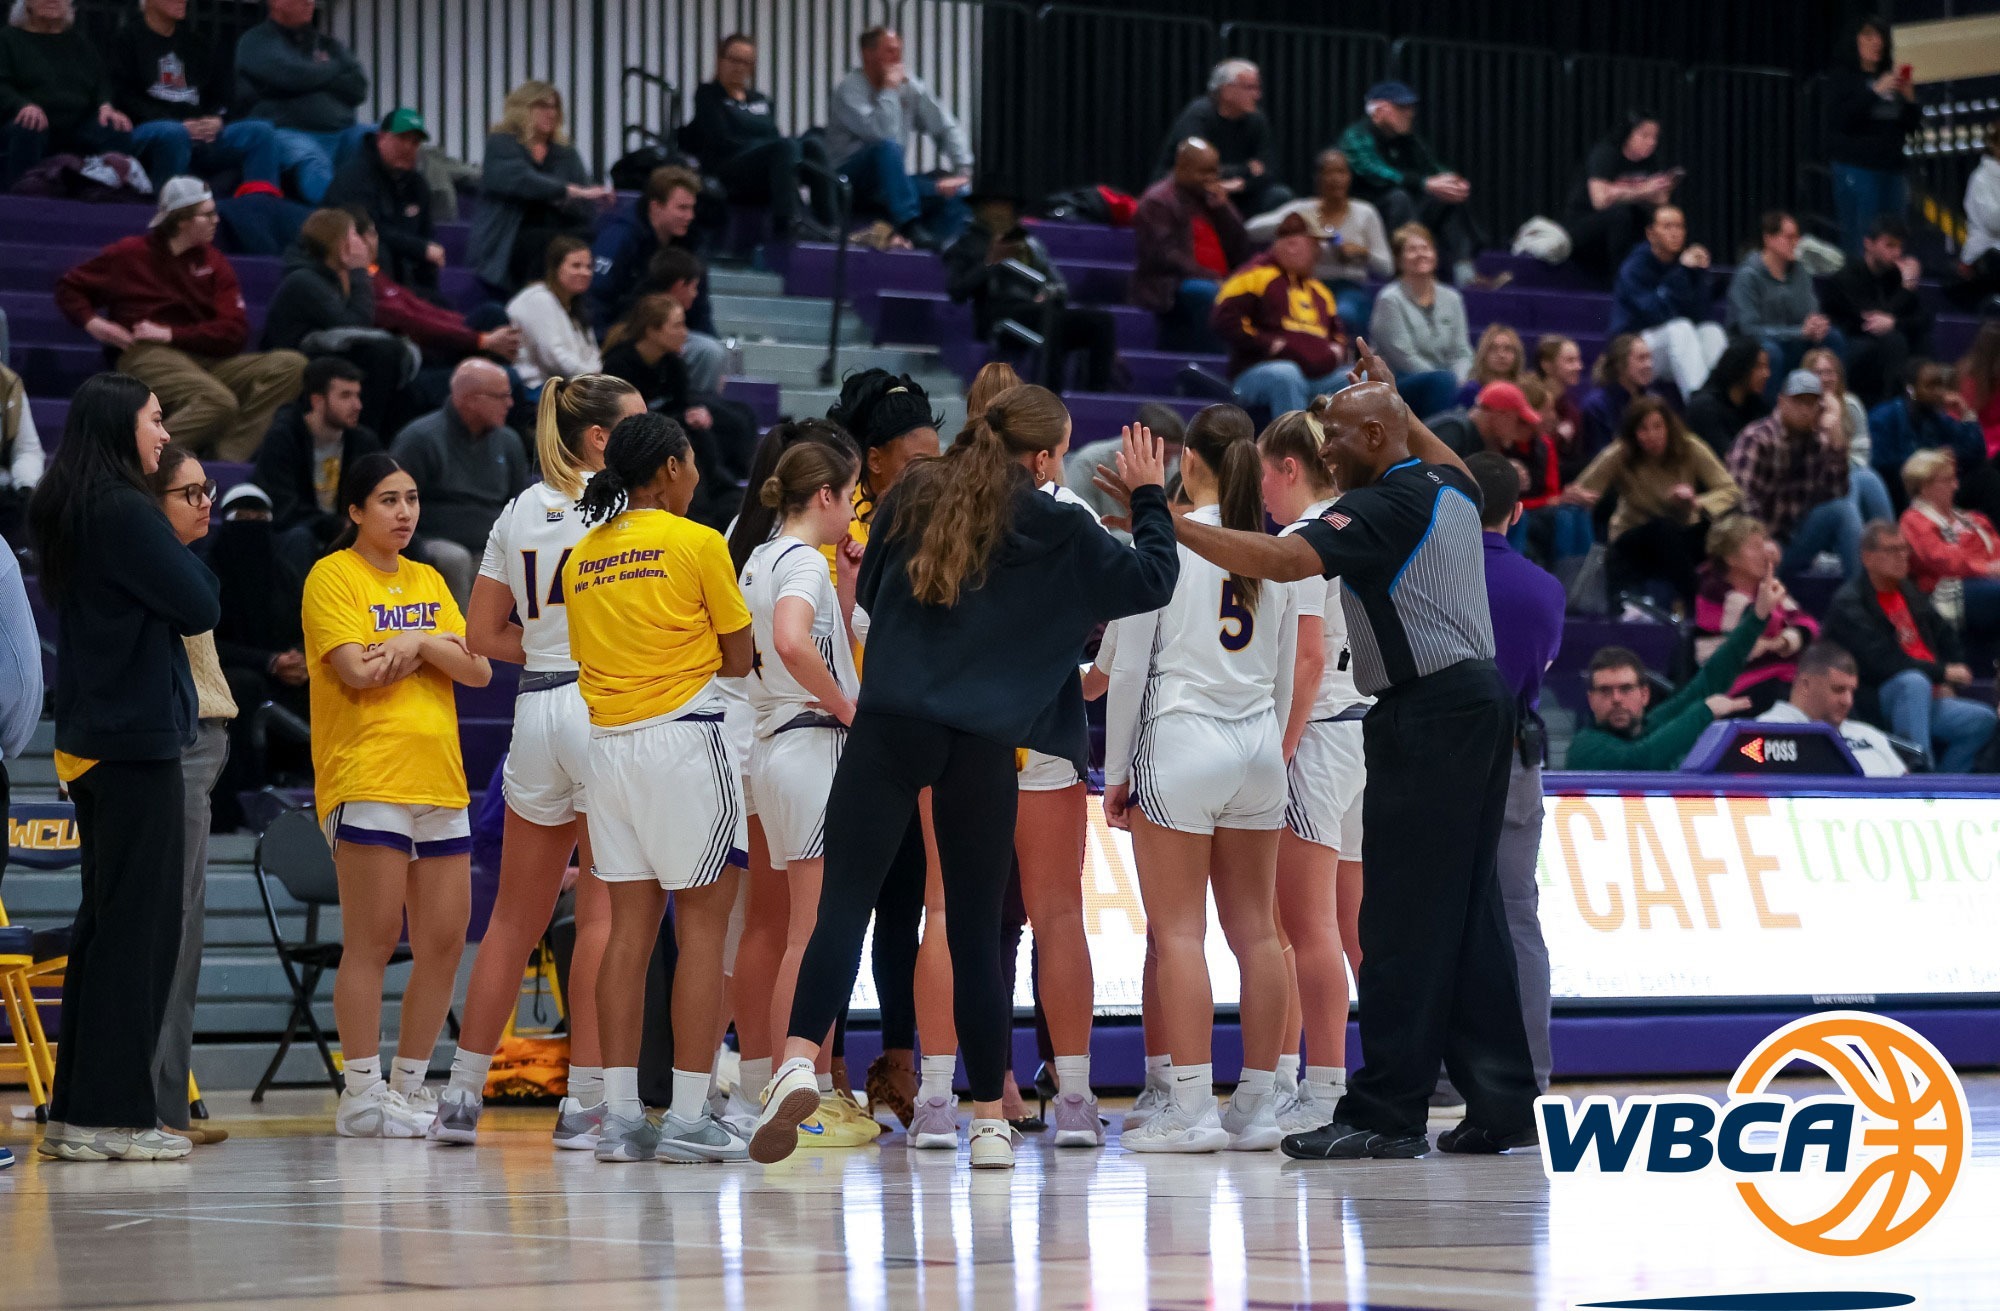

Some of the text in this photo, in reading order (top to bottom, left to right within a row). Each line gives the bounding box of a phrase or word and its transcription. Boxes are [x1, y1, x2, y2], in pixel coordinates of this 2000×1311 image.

[578, 549, 665, 576] Together
[574, 567, 668, 594] We Are Golden.
[369, 602, 441, 632] WCU
[1219, 578, 1254, 653] 5
[1764, 740, 1798, 762] POSS
[8, 818, 80, 850] WCU
[1784, 798, 2000, 901] tropic
[1554, 797, 1802, 932] CAFE
